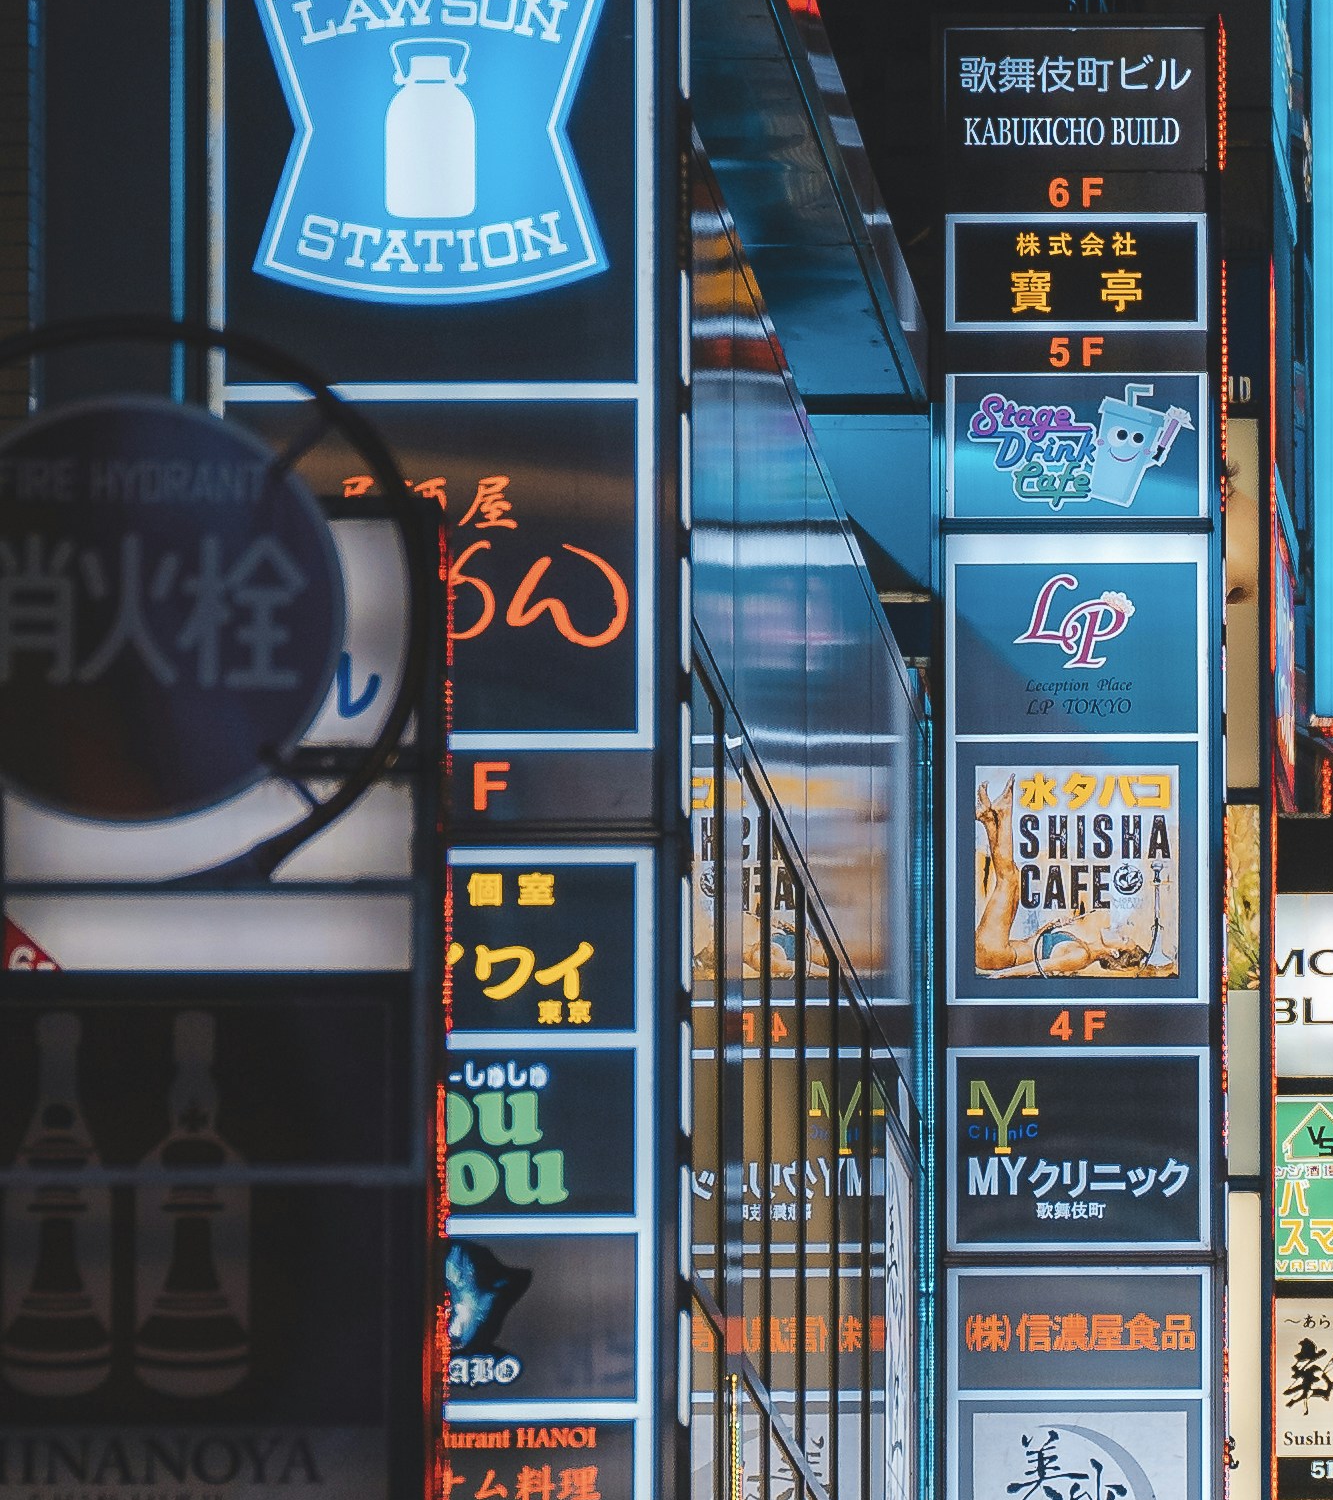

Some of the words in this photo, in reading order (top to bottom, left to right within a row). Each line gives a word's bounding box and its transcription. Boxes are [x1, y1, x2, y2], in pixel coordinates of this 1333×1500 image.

[958, 55, 1192, 94] 歌舞伎町ビル
[964, 117, 1105, 147] KABUKICHO
[1111, 117, 1180, 147] BUILD
[297, 211, 568, 272] STATION
[1016, 231, 1138, 258] 株式会社
[973, 395, 1080, 440] Stage
[996, 431, 1096, 472] Drink
[1015, 458, 1092, 504] Cafe
[1096, 678, 1132, 693] Place
[1063, 697, 1132, 716] TOKYO
[1020, 772, 1172, 810] 水タバコ
[1019, 814, 1171, 861] SHISHA
[468, 873, 555, 907] 個室
[1020, 864, 1110, 910] CAFE
[537, 1000, 592, 1025] 東京
[968, 1156, 1189, 1198] MYクリニック
[1036, 1202, 1106, 1219] 歌舞伎町
[516, 1427, 596, 1449] HANOI
[1284, 1430, 1331, 1446] Sushi
